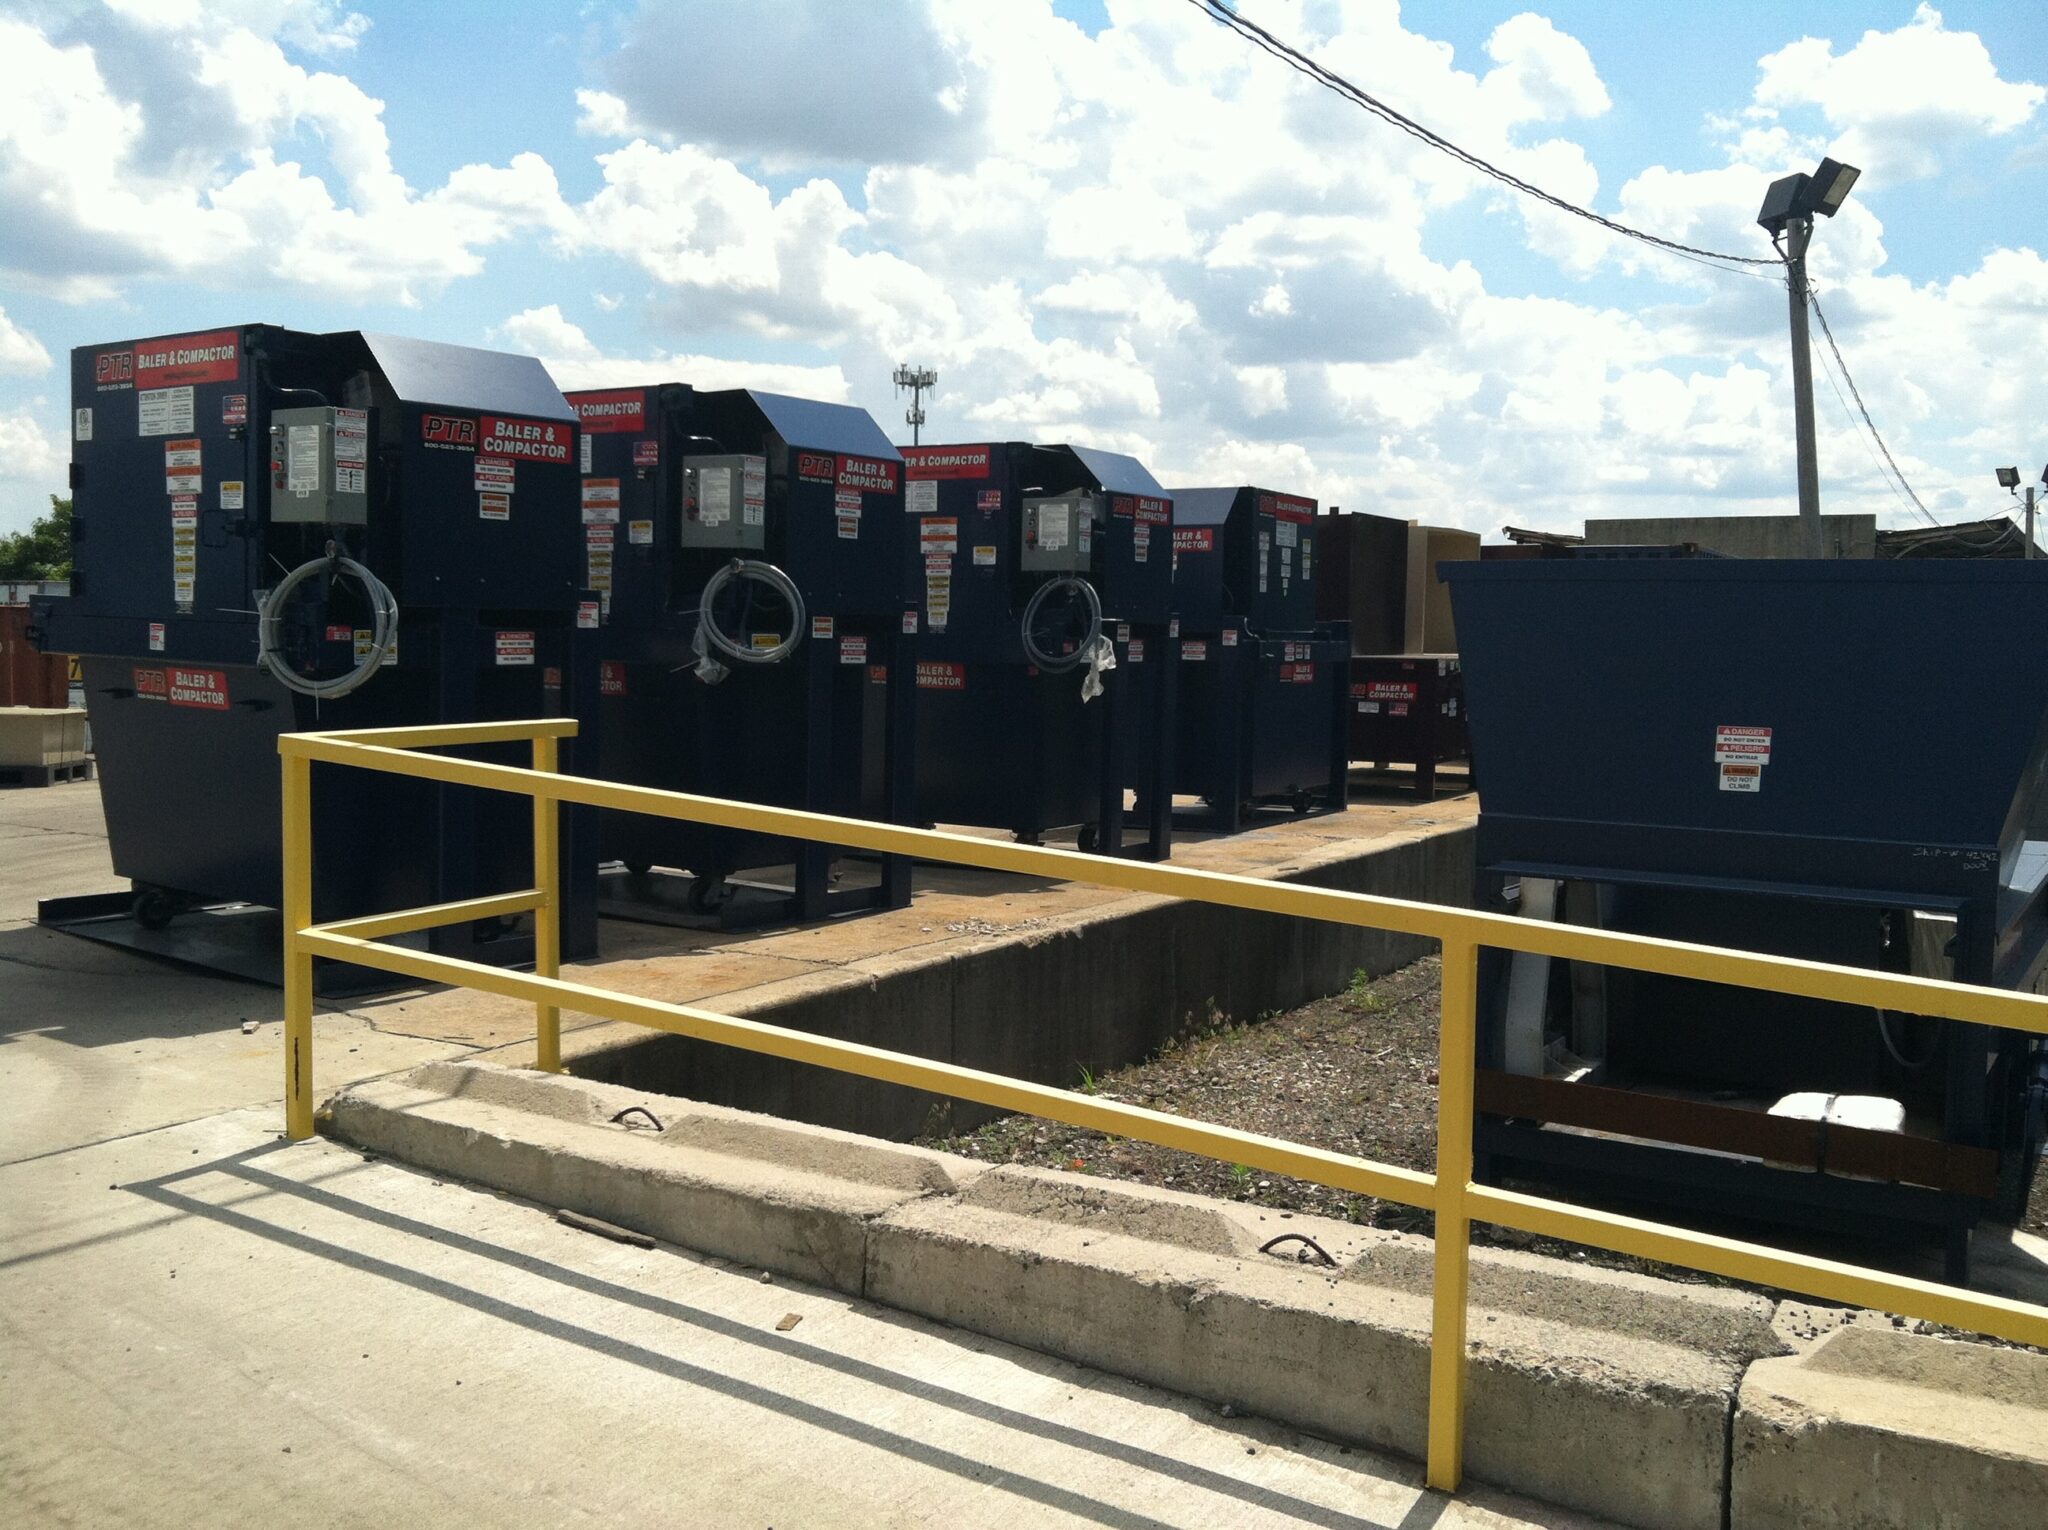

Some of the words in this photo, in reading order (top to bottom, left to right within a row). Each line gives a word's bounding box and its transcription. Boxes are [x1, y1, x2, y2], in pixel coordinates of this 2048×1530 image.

[138, 353, 167, 370] BALER
[168, 350, 176, 366] &
[177, 345, 235, 365] COMPACTOR
[96, 352, 133, 381] PTR
[582, 402, 642, 417] COMPACTOR
[425, 416, 476, 443] PTR
[495, 421, 541, 441] BALER
[545, 426, 555, 442] &
[483, 437, 567, 459] COMPACTOR
[485, 458, 510, 466] DANGER
[801, 454, 834, 477] PTR
[846, 459, 877, 475] BALER
[879, 464, 886, 477] &
[919, 455, 926, 467] &
[927, 454, 986, 466] COMPACTOR
[839, 473, 894, 490] COMPACTOR
[1194, 531, 1202, 541] &
[945, 666, 953, 676] &
[136, 669, 167, 694] PTR
[175, 672, 206, 688] BALER
[208, 674, 215, 689] &
[1375, 683, 1401, 692] BALER
[1401, 683, 1408, 692] &
[171, 687, 225, 705] COMPACTOR
[1369, 691, 1414, 699] COMPACTOR
[1731, 728, 1765, 736] DANGER
